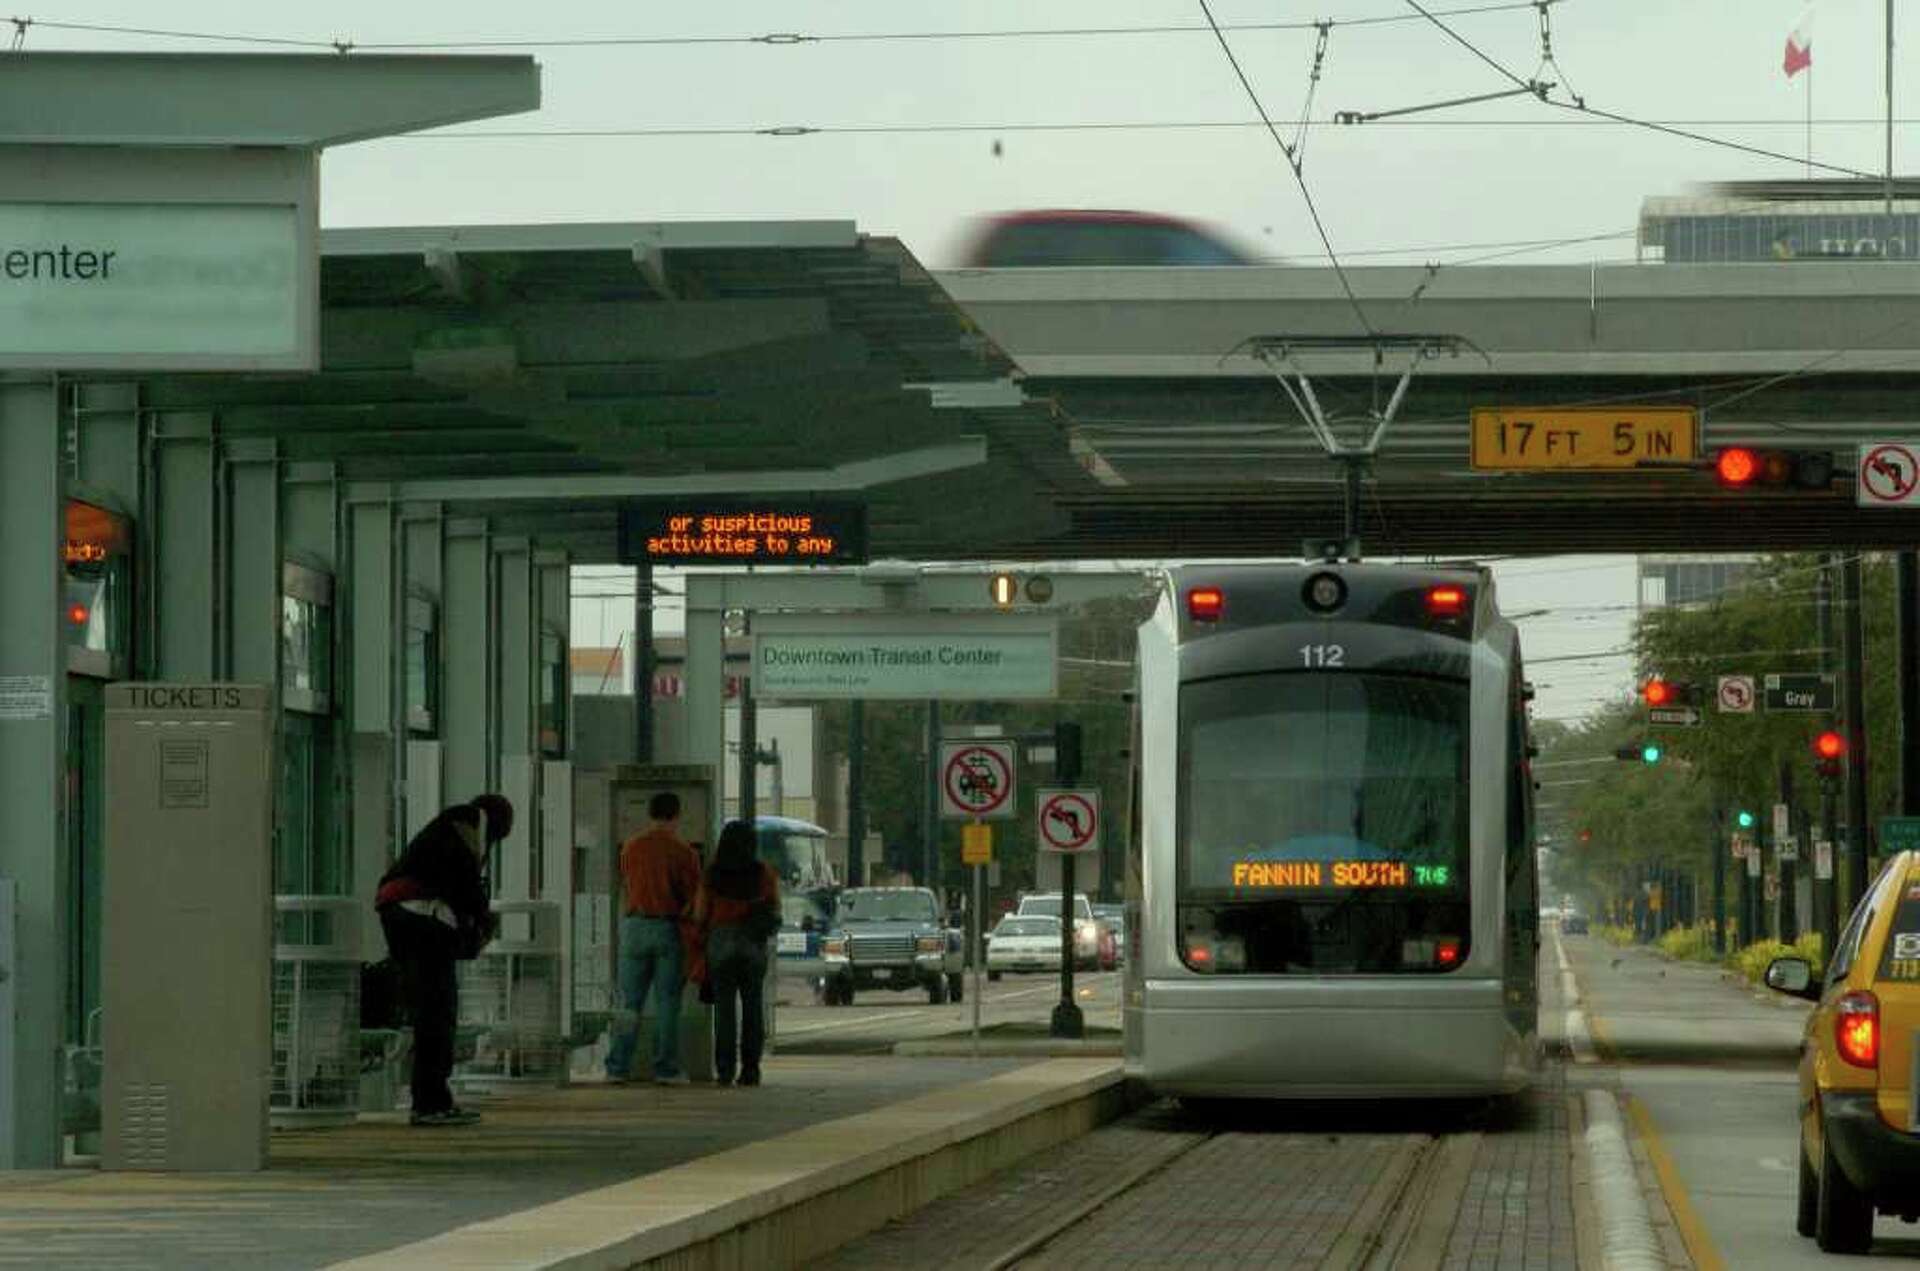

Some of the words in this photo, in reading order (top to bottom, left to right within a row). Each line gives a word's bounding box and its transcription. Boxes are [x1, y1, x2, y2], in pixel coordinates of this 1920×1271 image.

[0, 245, 116, 279] enter
[1500, 421, 1534, 455] 17
[1545, 431, 1580, 454] FT
[1613, 422, 1635, 455] 5
[1646, 431, 1673, 453] IN
[669, 515, 693, 532] or
[701, 514, 812, 534] suspicious
[647, 534, 757, 553] activities
[766, 534, 788, 553] to
[798, 536, 832, 554] any
[764, 648, 865, 665] Downtown
[870, 647, 932, 665] Transit
[938, 647, 1003, 665] Center
[1299, 644, 1344, 667] 112
[128, 687, 241, 709] TICKETS
[1785, 690, 1815, 711] Gray
[1234, 862, 1321, 886] FANNIN
[1333, 862, 1406, 886] SOUTH
